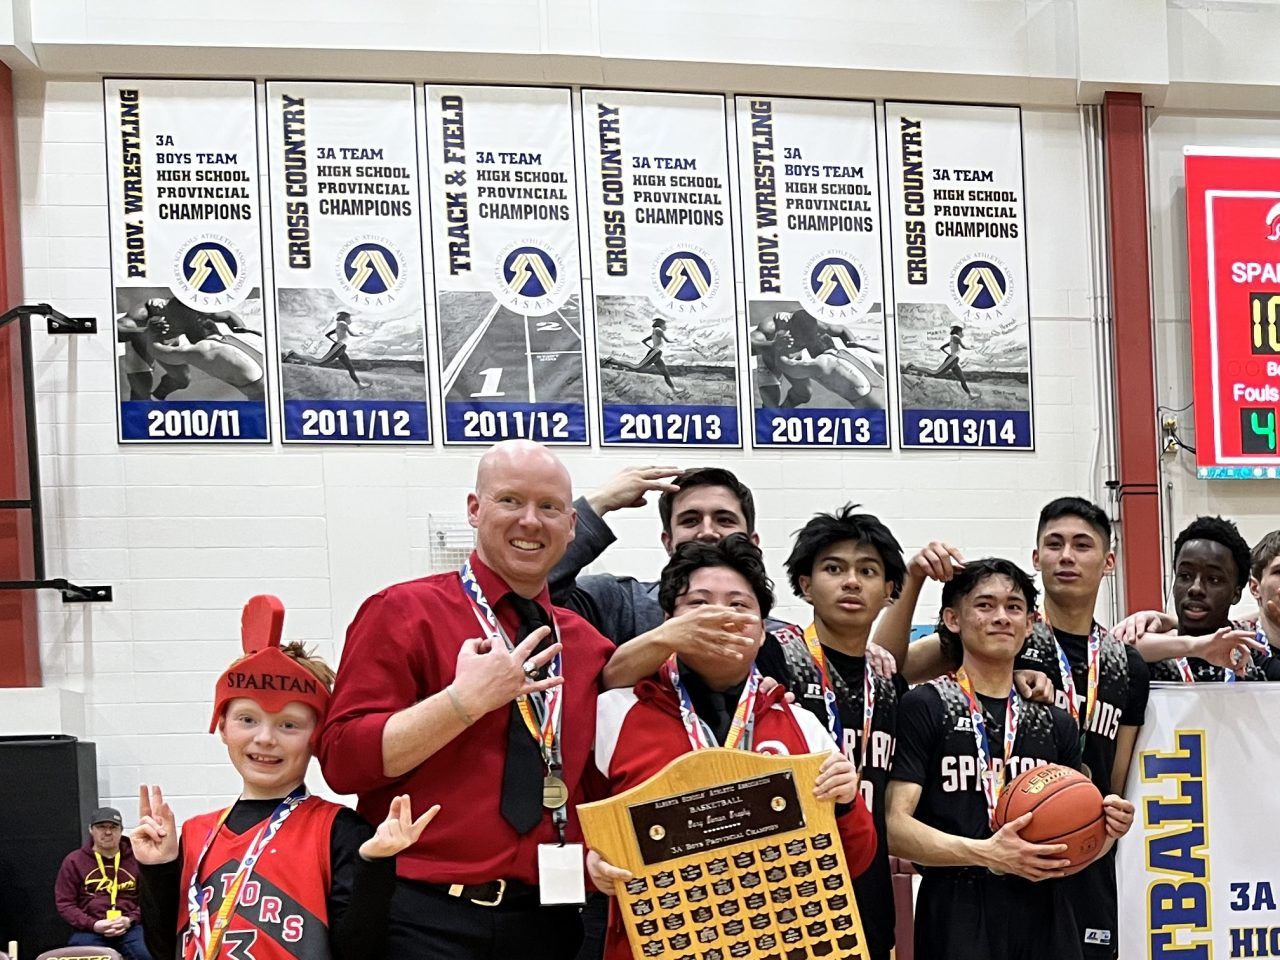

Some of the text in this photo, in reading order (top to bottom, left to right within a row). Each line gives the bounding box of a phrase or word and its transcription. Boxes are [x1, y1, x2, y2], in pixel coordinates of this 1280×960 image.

[156, 134, 174, 146] 3A
[156, 153, 238, 164] BOYS TEAM
[316, 148, 384, 160] 3A TEAM
[476, 152, 542, 165] 3A TEAM
[784, 148, 802, 160] 3A
[632, 156, 696, 170] 3A TEAM
[784, 164, 864, 178] BOYS TEAM
[156, 170, 250, 182] HIGH SCHOOL
[317, 166, 410, 179] HIGH SCHOOL
[476, 170, 568, 184] HIGH SCHOOL
[933, 169, 994, 182] 3A TEAM
[119, 89, 147, 278] PROV. WRESTLING
[282, 94, 312, 270] CROSS COUNTRY
[318, 182, 410, 196] PROVINCIAL
[441, 95, 471, 275] TRACK & FIELD
[598, 103, 628, 276] CROSS COUNTRY
[633, 175, 722, 188] HIGH SCHOOL
[785, 182, 872, 196] HIGH SCHOOL
[158, 187, 250, 199] PROVINCIAL
[478, 186, 567, 200] PROVINCIAL
[634, 192, 722, 205] PROVINCIAL
[750, 101, 781, 294] PROV. WRESTLING
[900, 117, 928, 285] CROSS COUNTRY
[933, 189, 1017, 202] HIGH SCHOOL
[158, 203, 252, 220] CHAMPIONS
[319, 199, 412, 217] CHAMPIONS
[478, 203, 570, 220] CHAMPIONS
[786, 198, 871, 212] PROVINCIAL
[934, 205, 1016, 218] PROVINCIAL
[636, 208, 724, 226] CHAMPIONS
[788, 214, 873, 232] CHAMPIONS
[936, 221, 1018, 238] CHAMPIONS
[470, 368, 505, 397] 1
[1233, 384, 1280, 402] Fouls
[148, 408, 240, 438] 2010/11
[302, 408, 410, 438] 2011/12
[463, 409, 569, 438] 2011/12
[620, 414, 722, 440] 2012/13
[772, 416, 870, 444] 2012/13
[1251, 411, 1275, 450] 4
[919, 418, 1016, 446] 2013/14
[227, 672, 318, 695] SPARTAN
[689, 797, 743, 813] BASKETBALL
[1230, 882, 1276, 911] 3A
